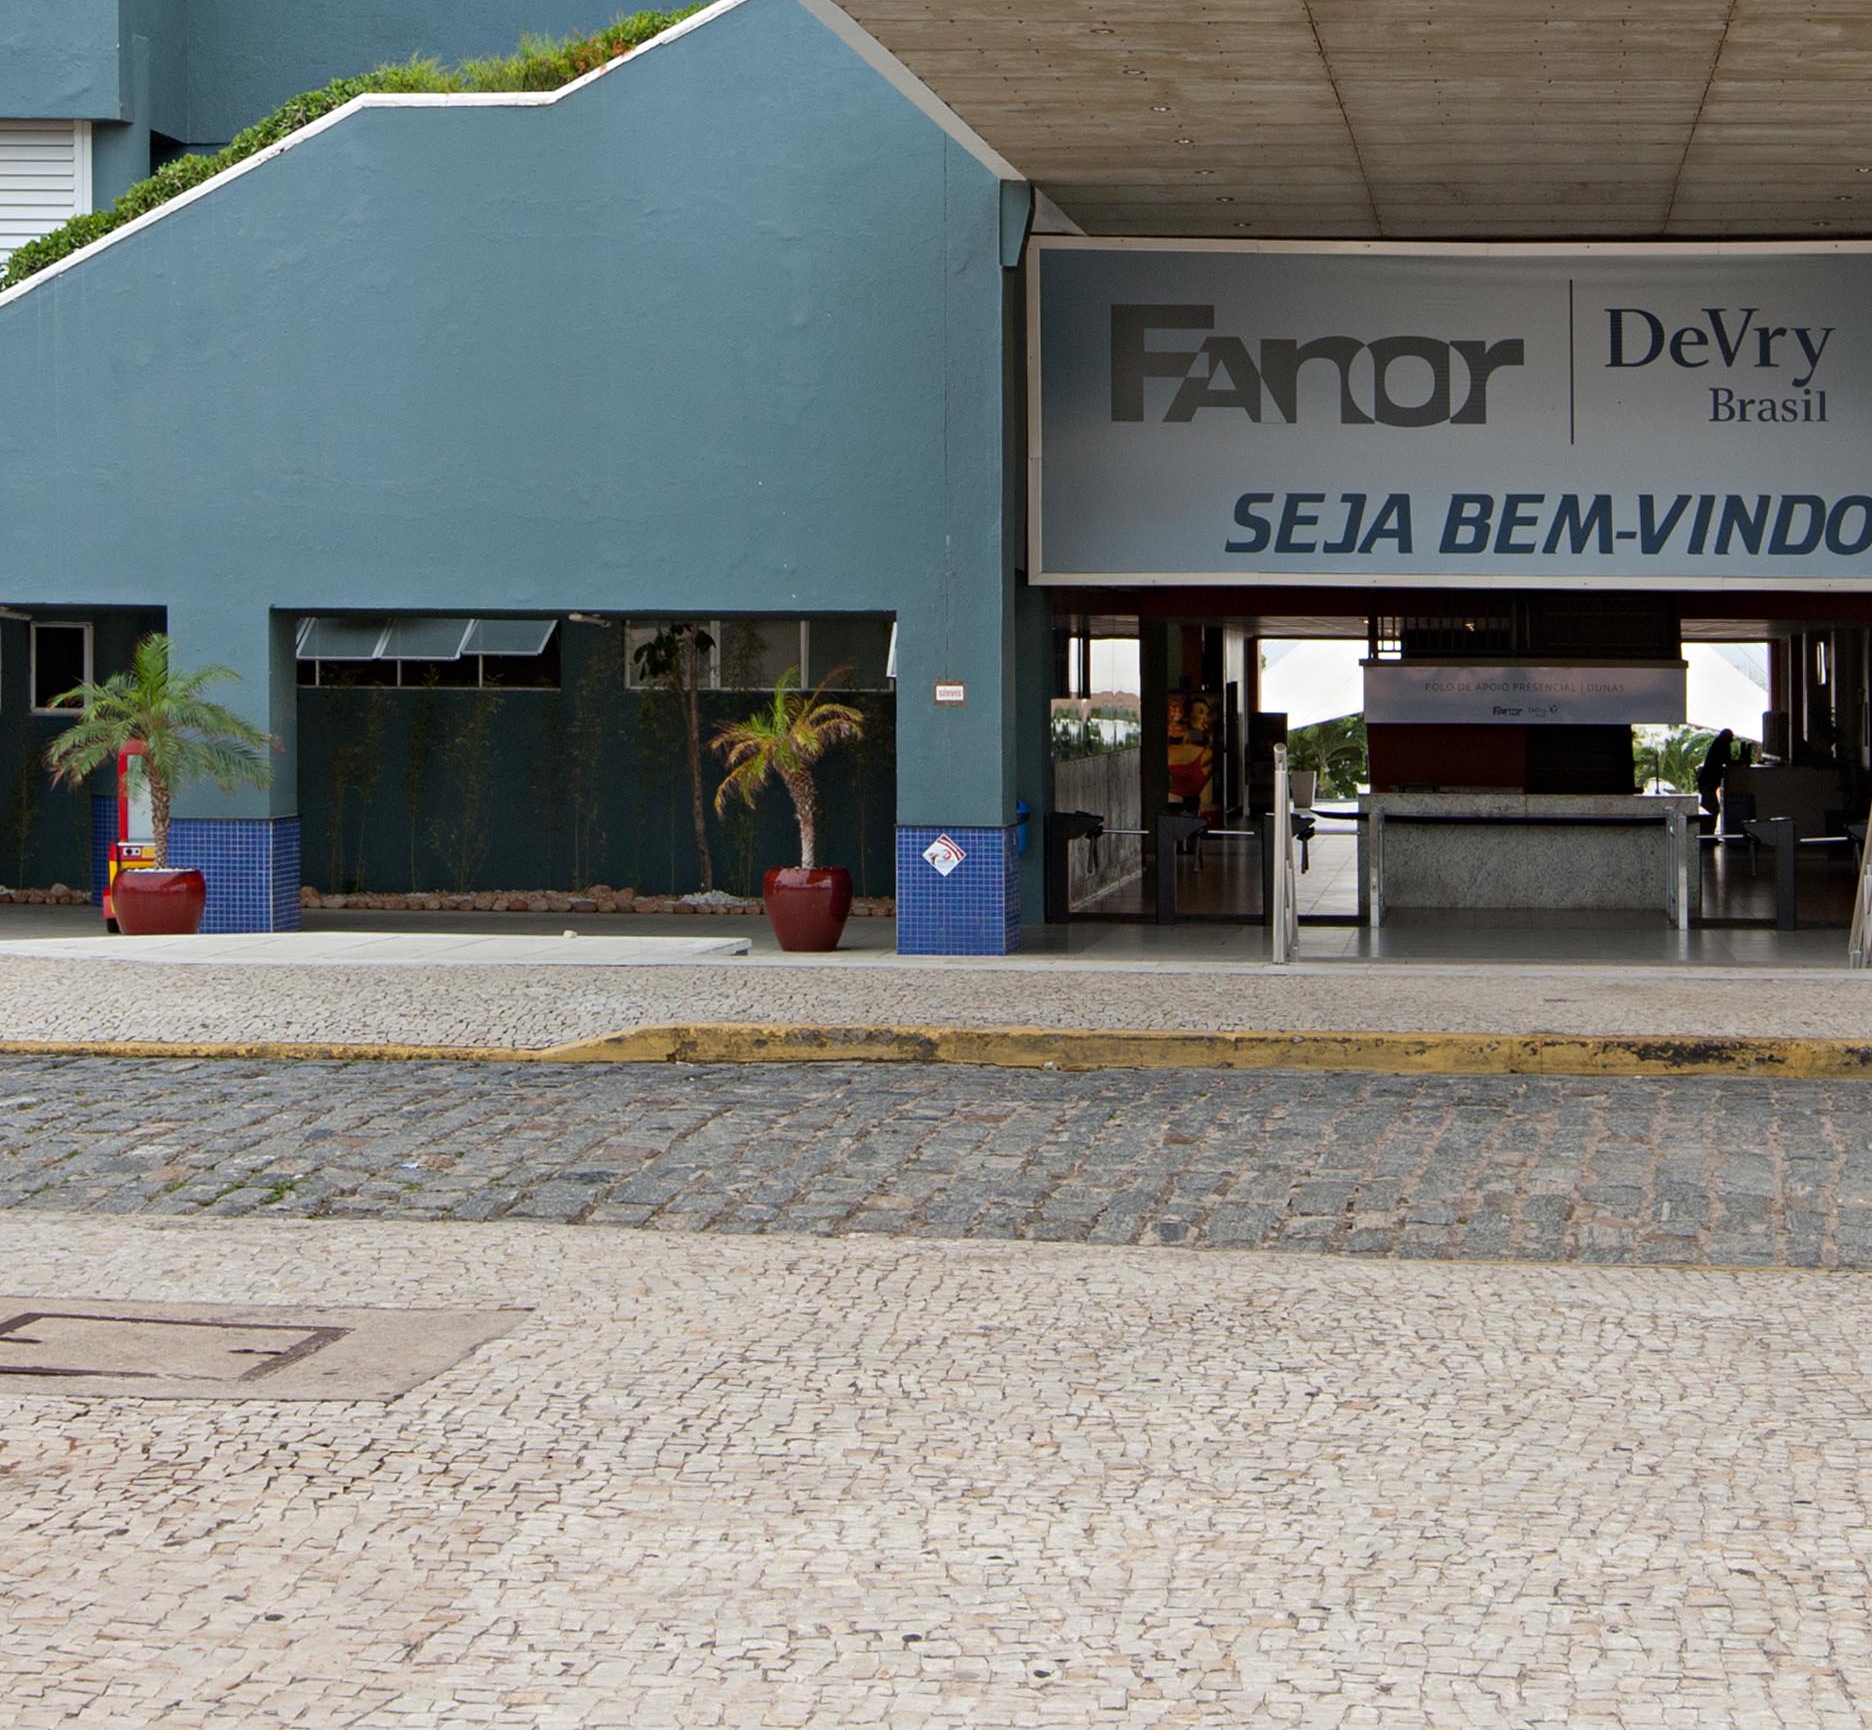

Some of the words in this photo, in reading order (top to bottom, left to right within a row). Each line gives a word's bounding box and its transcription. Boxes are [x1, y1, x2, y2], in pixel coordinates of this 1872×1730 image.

[1606, 308, 1836, 388] DeVry
[1709, 387, 1829, 424] Brasil
[1225, 493, 1414, 555] SEJA
[1424, 682, 1453, 692] POLO
[1457, 682, 1471, 692] DE
[1475, 682, 1509, 692] APOIO
[1512, 682, 1577, 693] PRESENCIAL
[1587, 683, 1625, 693] DUNAS
